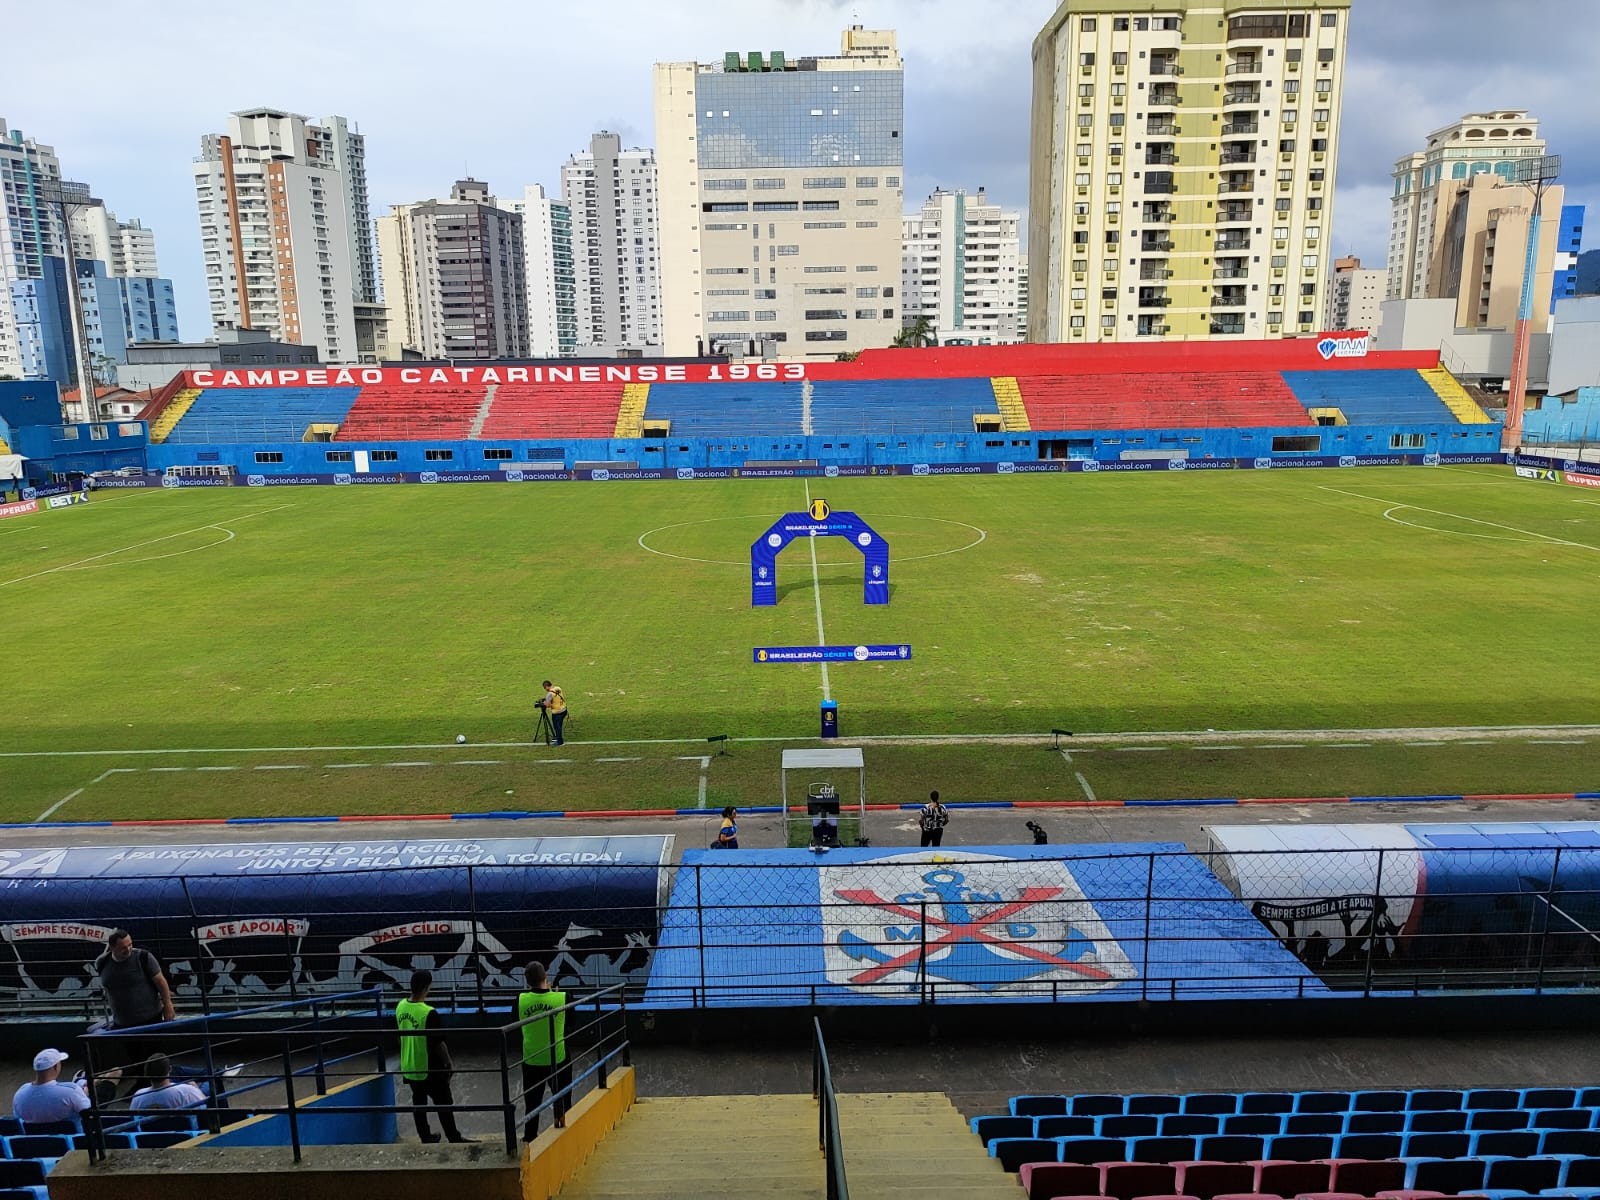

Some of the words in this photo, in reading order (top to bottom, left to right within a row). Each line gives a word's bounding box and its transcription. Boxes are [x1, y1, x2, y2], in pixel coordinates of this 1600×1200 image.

[193, 368, 383, 386] CAMPEÃO
[400, 365, 686, 383] CATARINENSE
[707, 364, 805, 380] 1963
[997, 461, 1060, 473] betnacional.co
[1082, 460, 1152, 472] betnacional.com
[1168, 458, 1231, 470] betnacional.co
[1254, 457, 1323, 469] betnacional.com
[1339, 455, 1400, 467] betnacional.co
[592, 468, 661, 480] betnacional.com
[912, 463, 981, 475] betnacional.com
[163, 475, 224, 487] betnacional.co
[247, 475, 318, 487] betnacional.com
[333, 473, 398, 485] betnacional.co
[420, 471, 490, 483] betnacional.com
[506, 470, 568, 481] betnacional.co
[769, 651, 823, 660] BRASILEIRÃO
[824, 651, 847, 659] SÉRIE
[820, 785, 835, 794] cbf
[107, 846, 289, 861] APAIXONADOS
[294, 845, 356, 857] PELO
[361, 842, 485, 855] MARCÍLIO,
[238, 857, 337, 870] JUNTOS
[343, 856, 402, 867] PELA
[409, 854, 497, 866] MESMA
[505, 851, 623, 863] TORCIDA!
[1260, 906, 1294, 920] SEMPRE
[1296, 902, 1329, 918] ESTAREI
[1330, 901, 1336, 912] A
[1338, 899, 1347, 910] TE
[1349, 897, 1374, 908] APOIA
[15, 924, 57, 937] SEMPRE
[61, 925, 105, 939] ESTAREI
[219, 925, 236, 935] TE
